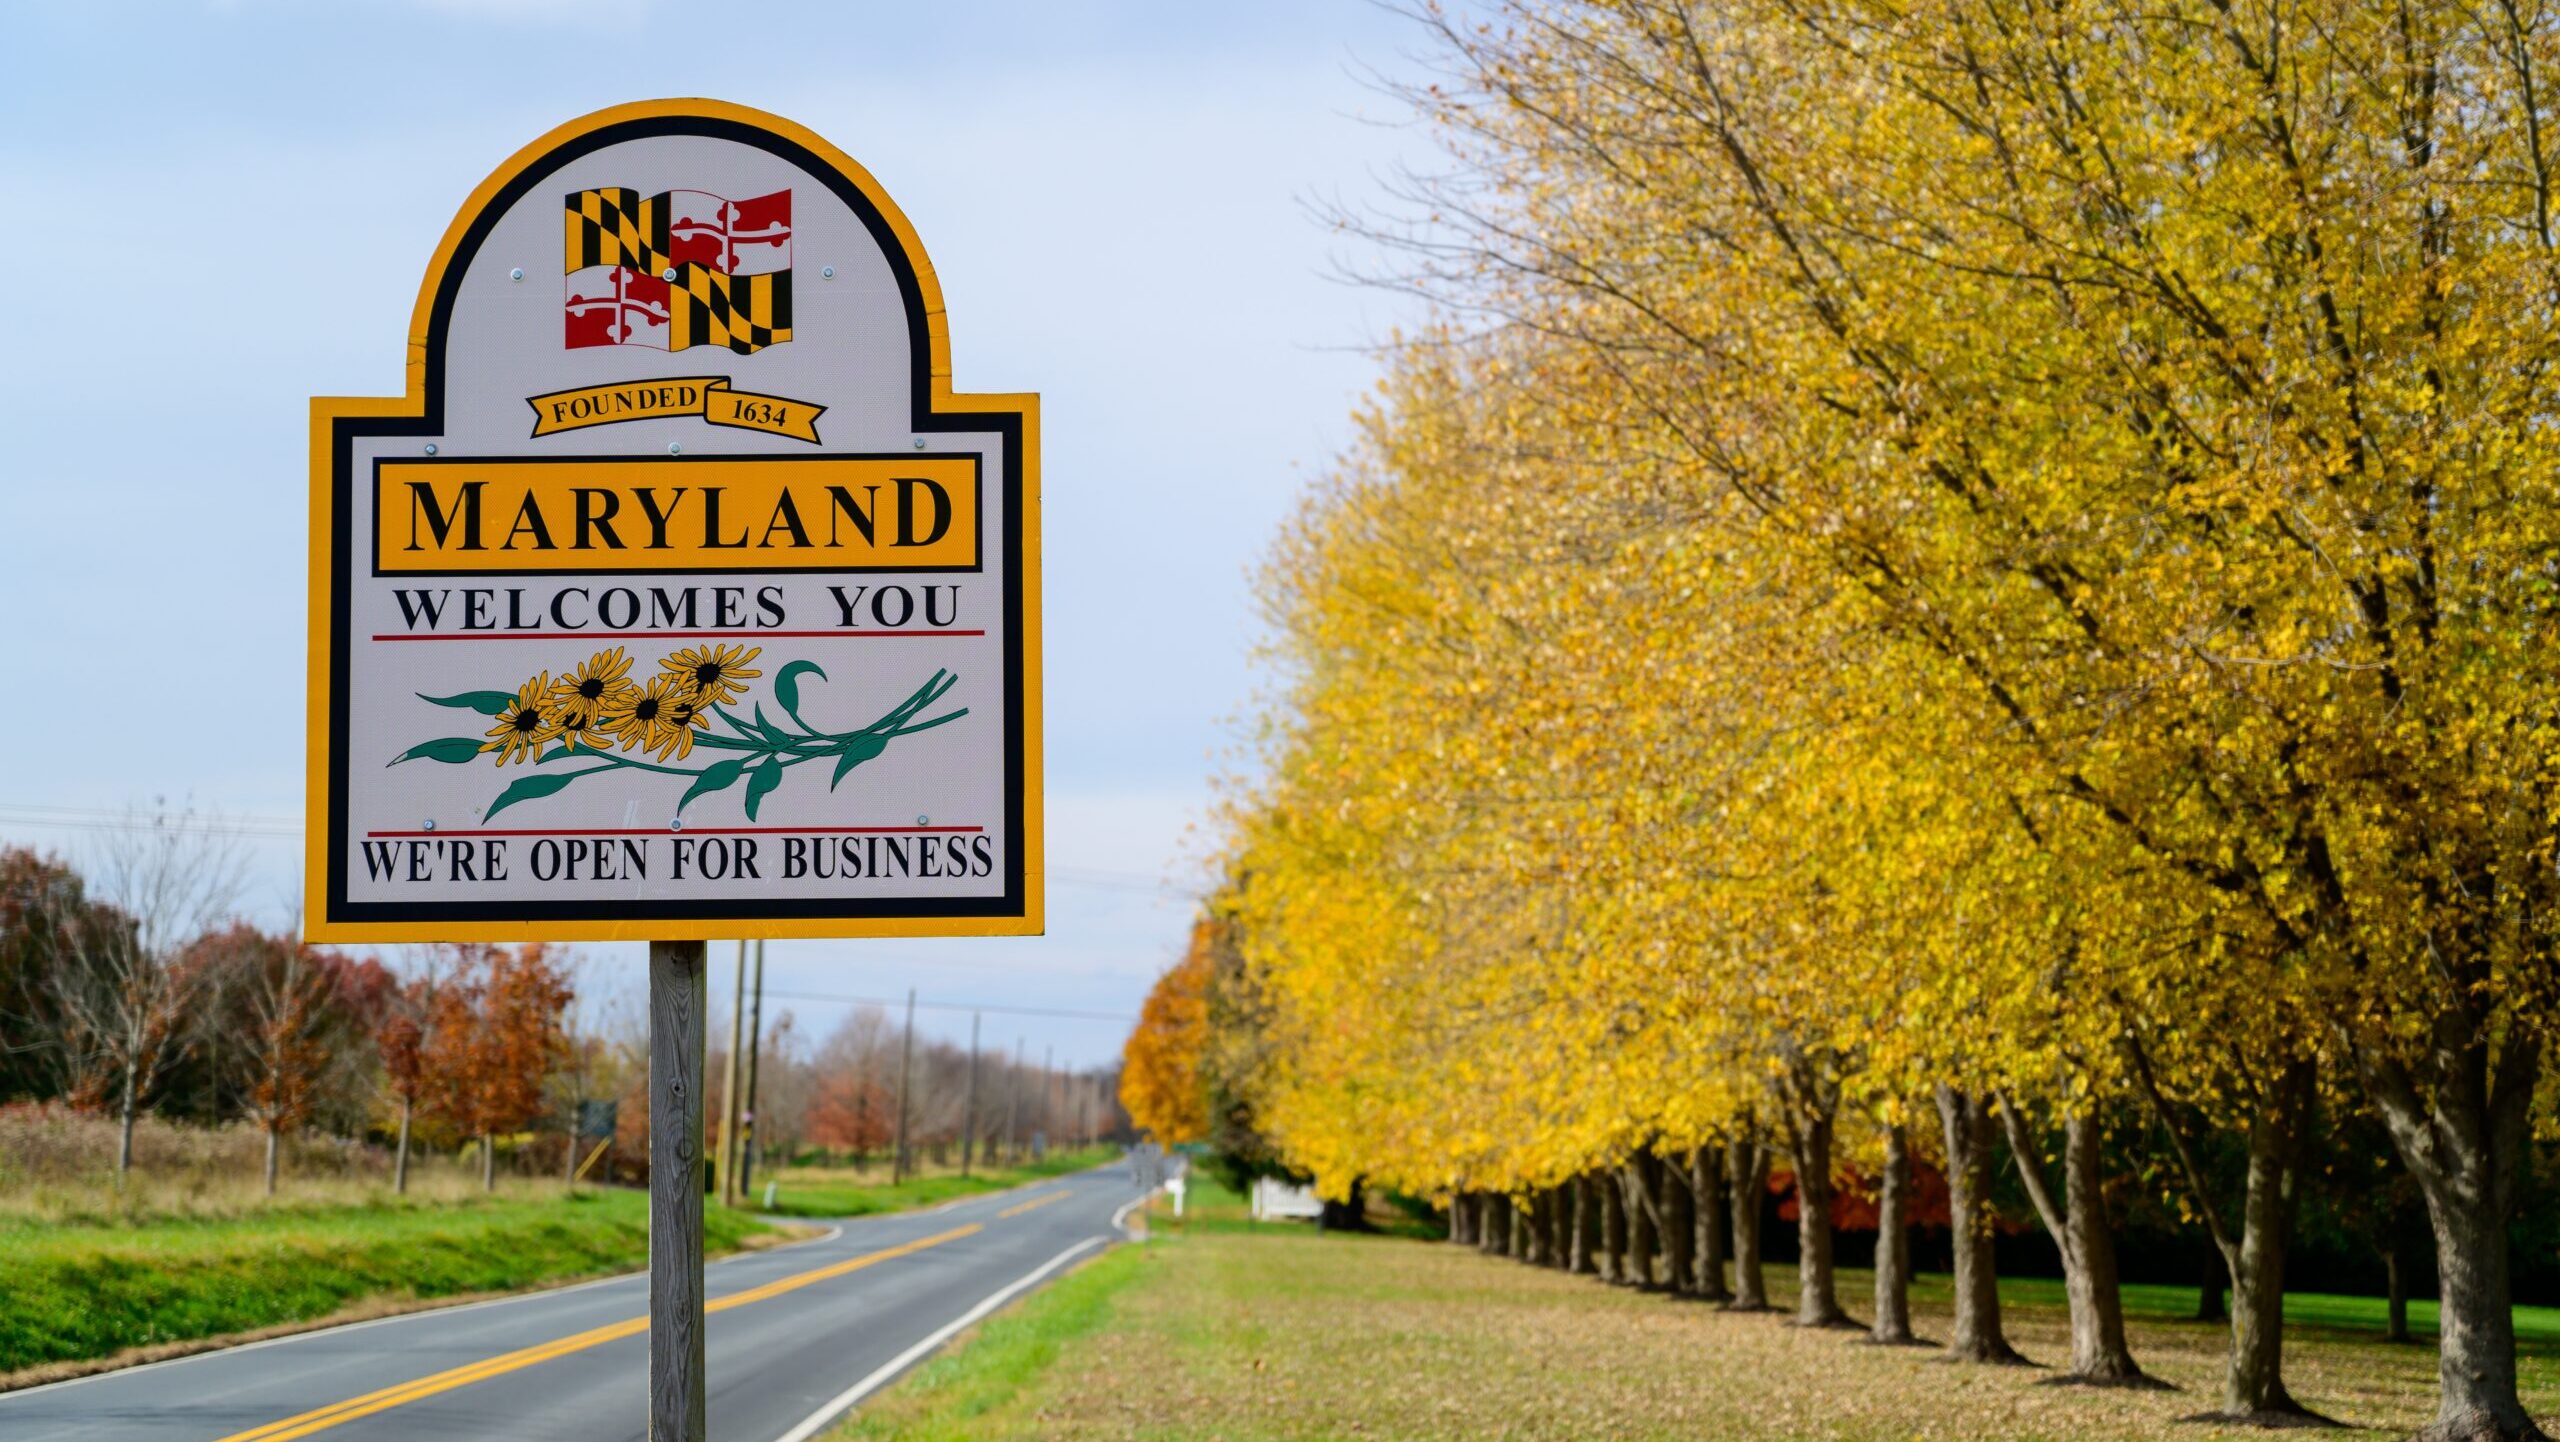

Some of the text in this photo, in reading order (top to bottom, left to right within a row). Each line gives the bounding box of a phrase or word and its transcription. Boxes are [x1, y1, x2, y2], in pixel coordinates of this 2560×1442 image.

[552, 385, 787, 427] FOUNDED 1634
[403, 477, 952, 551] MARYLAND
[392, 585, 962, 631] WELCOMES YOU
[360, 835, 993, 883] WE'RE OPEN FOR BUSINESS
